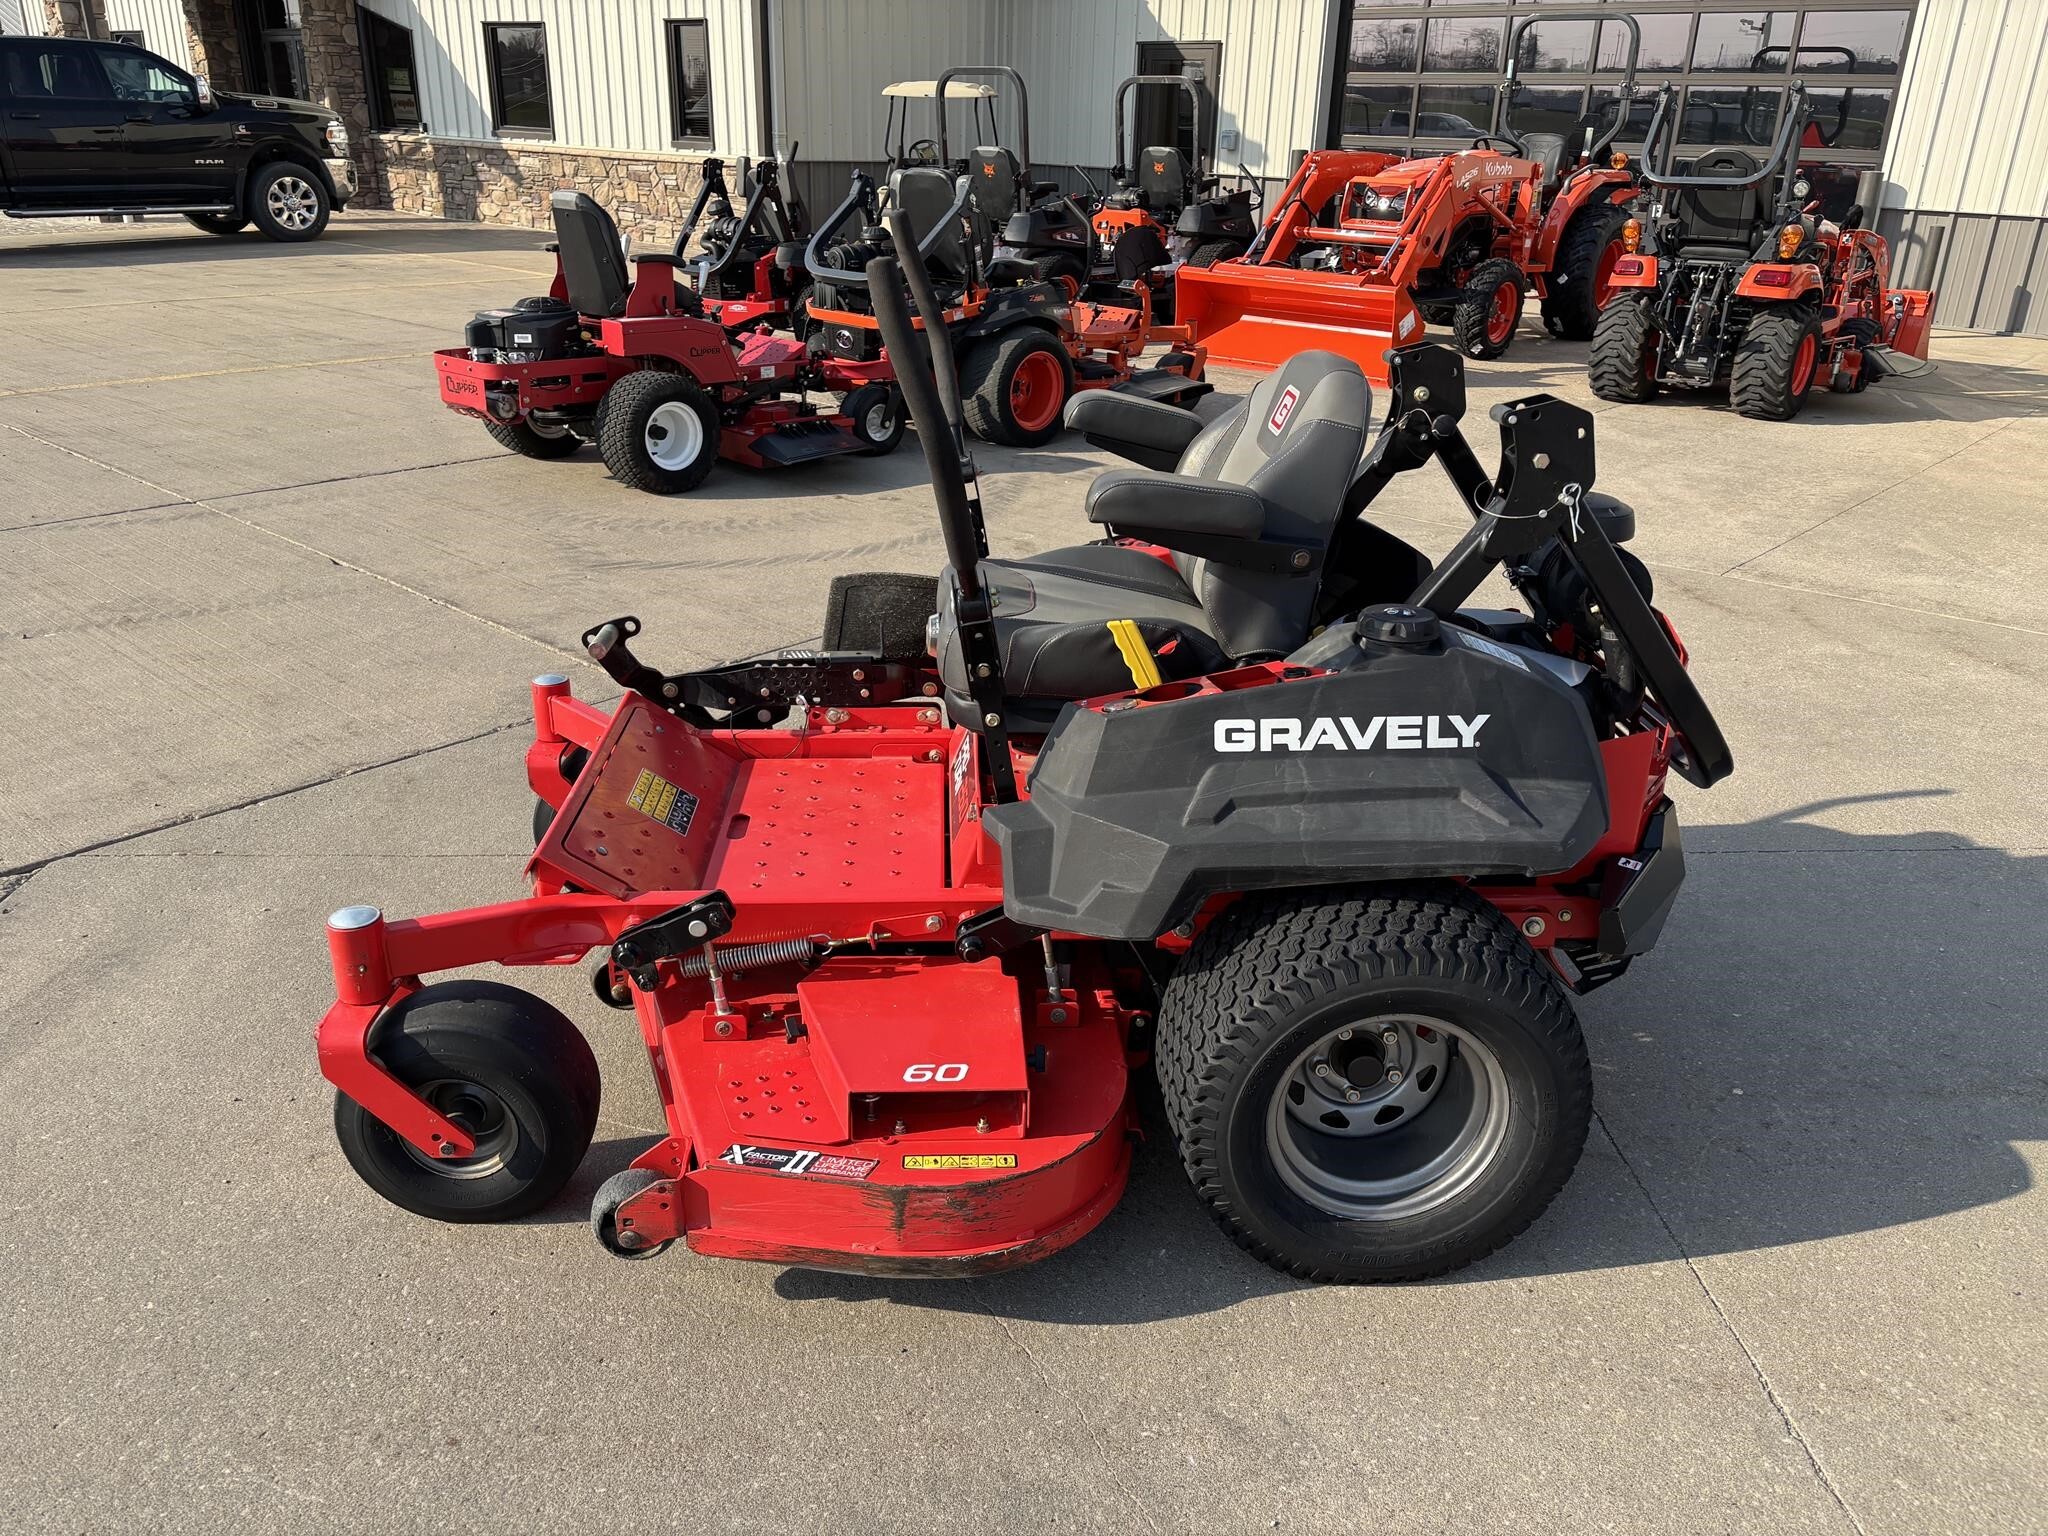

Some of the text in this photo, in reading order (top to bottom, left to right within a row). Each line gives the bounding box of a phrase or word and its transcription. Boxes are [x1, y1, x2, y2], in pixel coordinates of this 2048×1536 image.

[1485, 161, 1513, 176] Kubota
[1456, 166, 1479, 189] LA526
[1213, 714, 1491, 752] GRAVELY
[903, 1063, 969, 1083] 60
[815, 1161, 871, 1173] LIFETIME
[819, 1155, 874, 1169] LIMITED
[808, 1167, 868, 1178] WARRANTY
